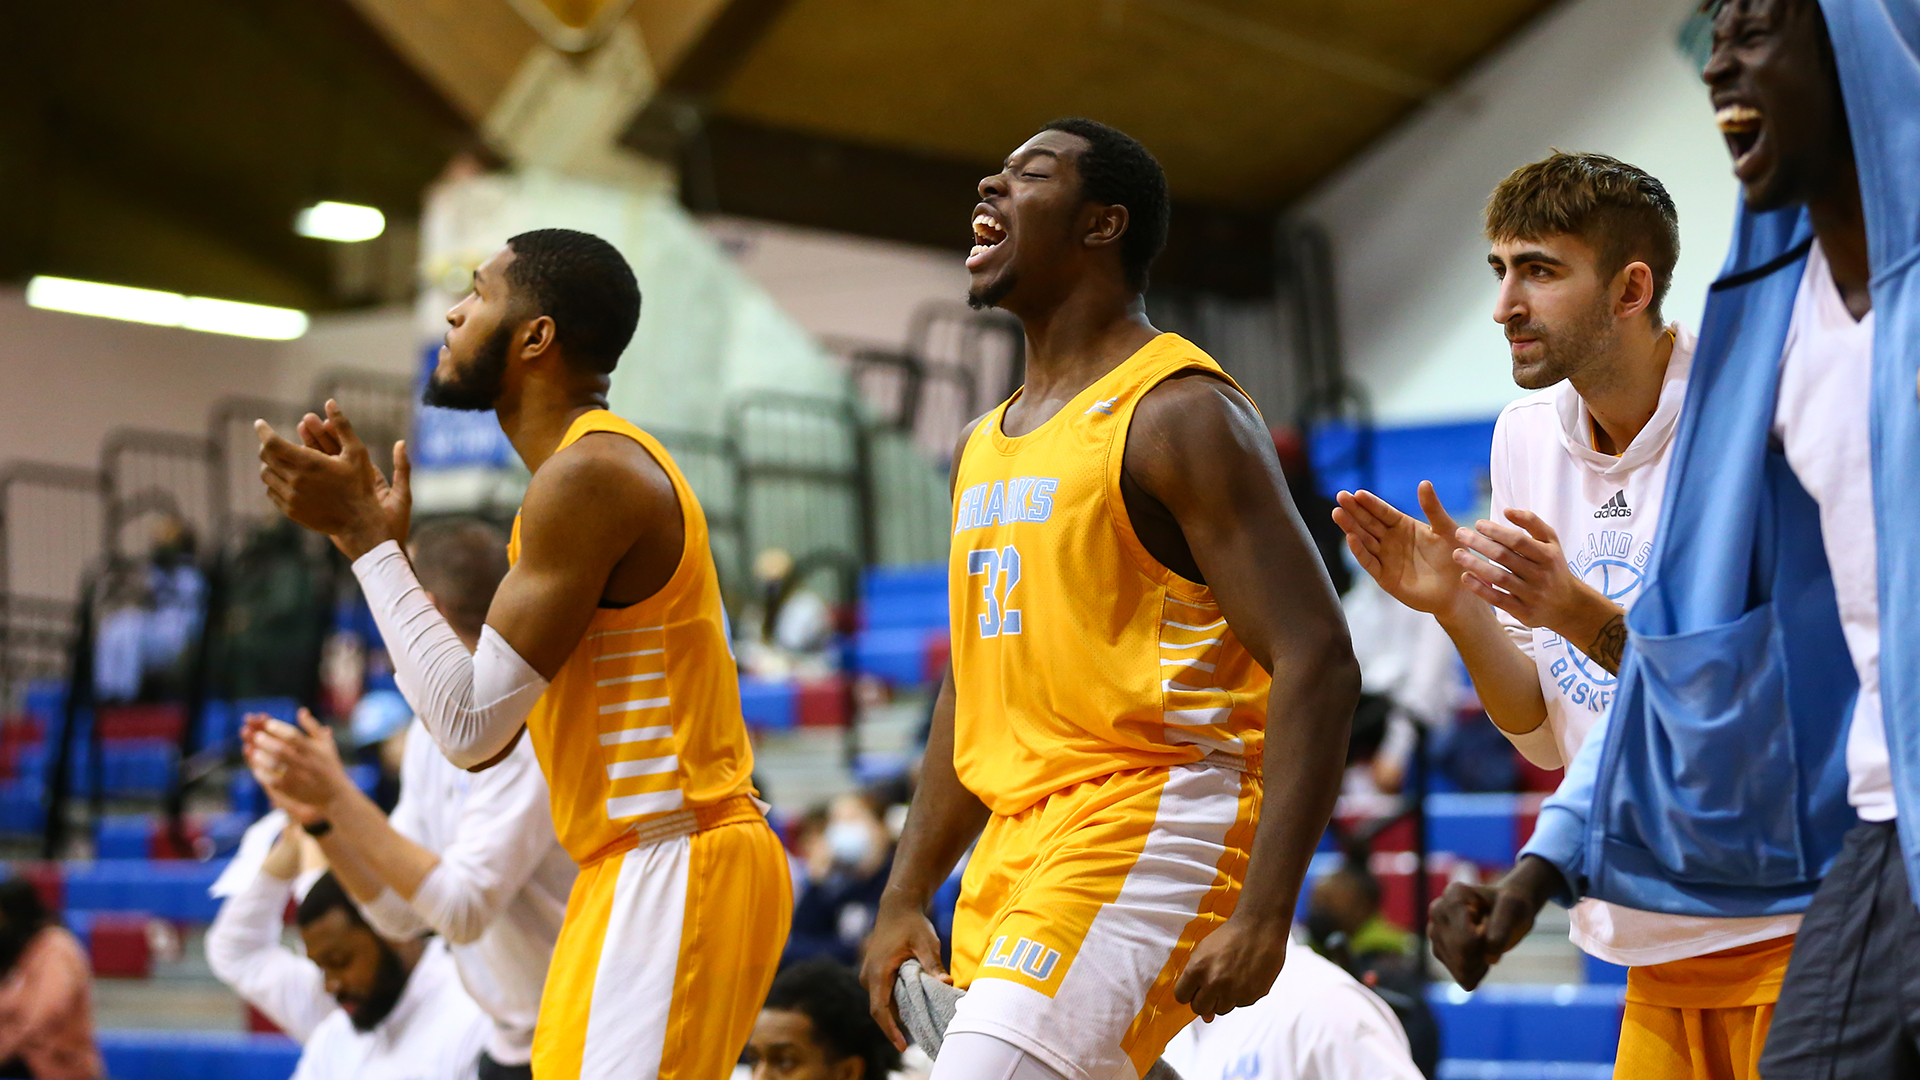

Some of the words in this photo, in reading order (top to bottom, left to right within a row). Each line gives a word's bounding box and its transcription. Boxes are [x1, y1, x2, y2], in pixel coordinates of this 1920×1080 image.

[1593, 506, 1632, 519] addas
[967, 544, 1022, 639] 32
[1550, 657, 1618, 712] BASKE
[983, 935, 1062, 982] LIU
